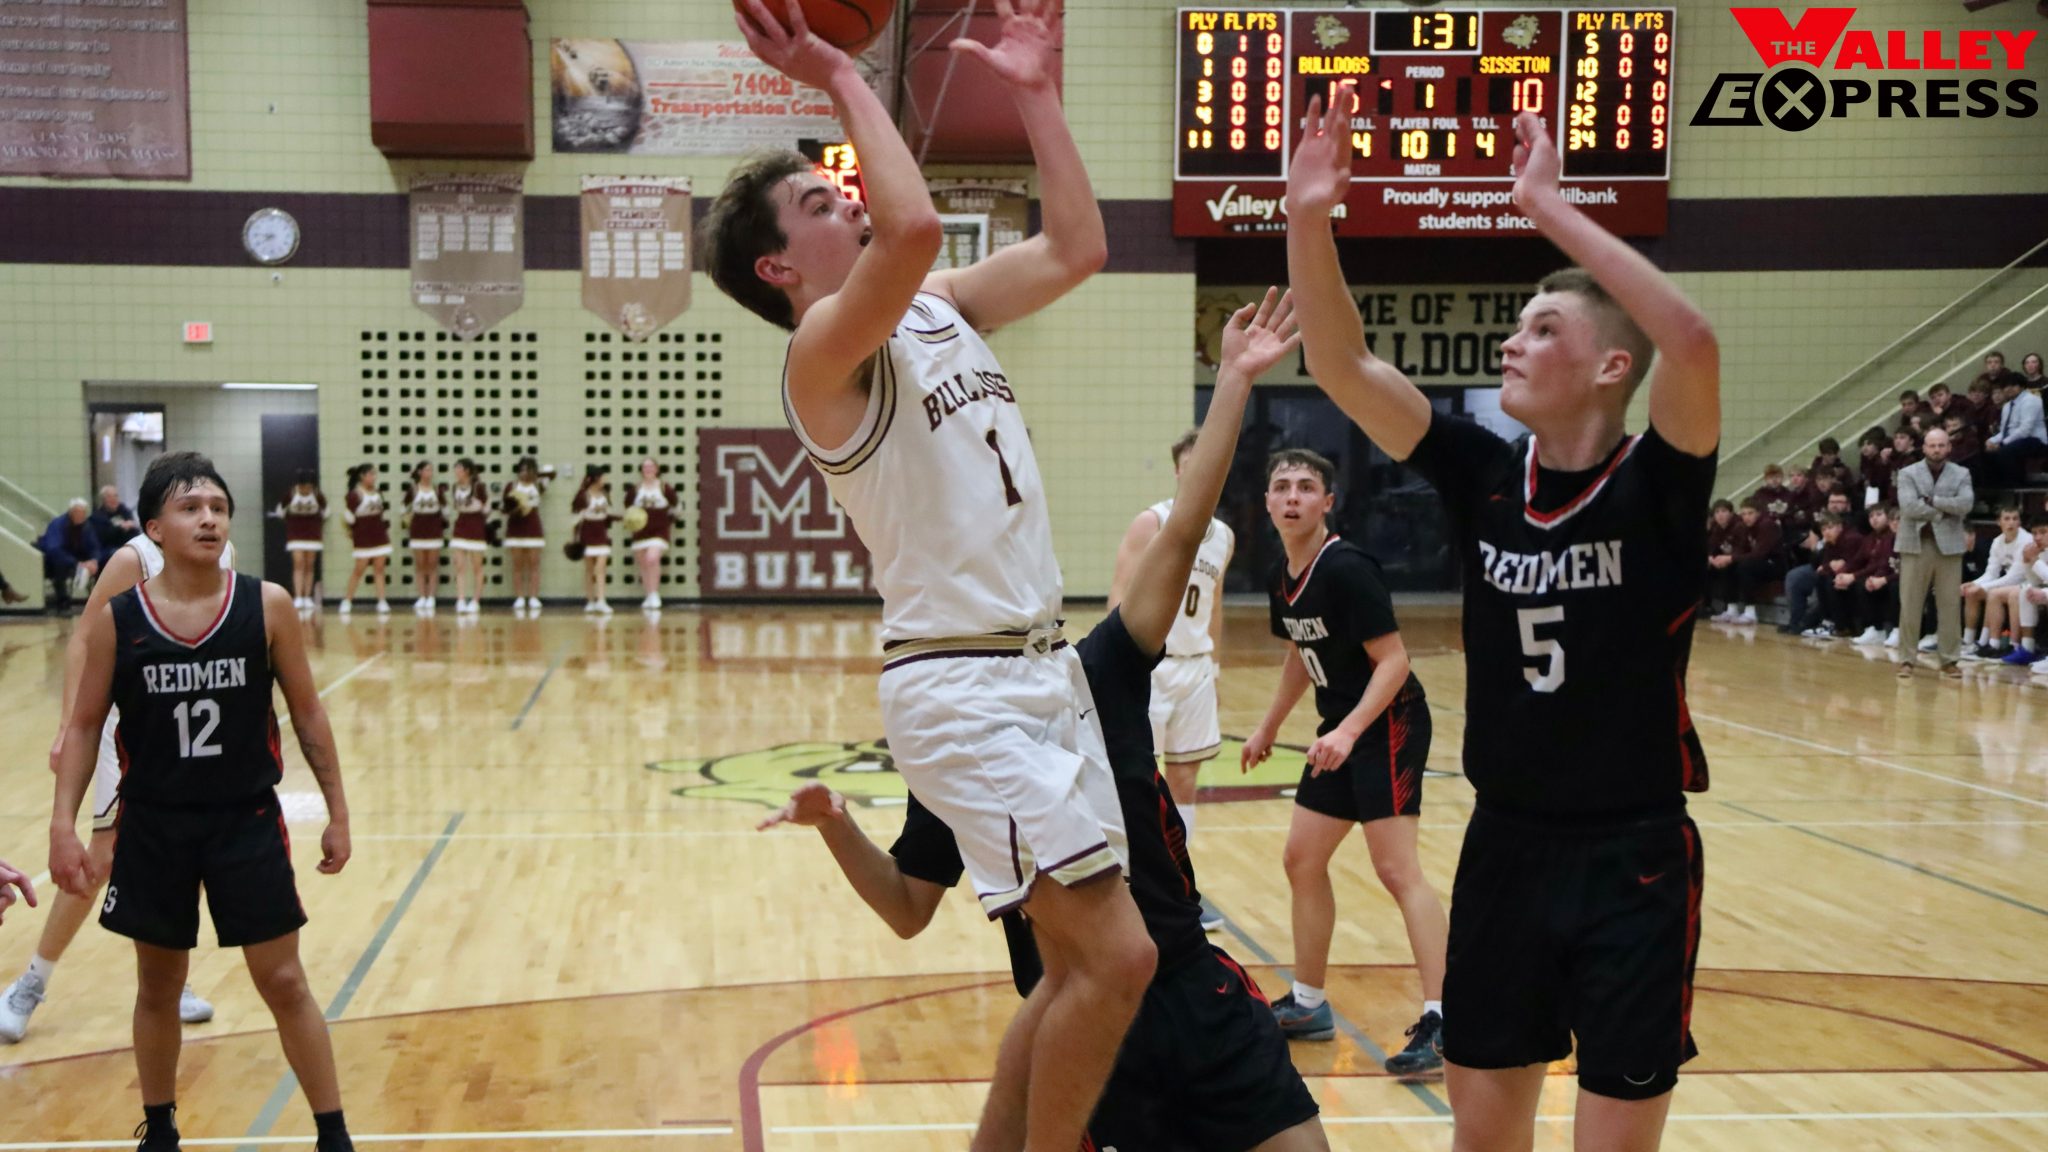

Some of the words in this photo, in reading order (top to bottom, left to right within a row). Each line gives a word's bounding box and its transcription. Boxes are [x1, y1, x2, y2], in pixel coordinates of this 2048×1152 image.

[1189, 13, 1217, 30] PLY
[1224, 13, 1243, 30] FL
[1246, 13, 1277, 30] PTS
[1413, 13, 1477, 49] 1:31
[1577, 13, 1604, 30] PLY
[1611, 13, 1629, 30] FL
[1634, 13, 1664, 30] PTS
[1197, 33, 1213, 54] 0
[1240, 35, 1247, 52] 1
[1267, 33, 1281, 54] 0
[1585, 33, 1599, 54] 5
[1619, 33, 1633, 53] 0
[1654, 33, 1668, 53] 0
[1204, 58, 1213, 77] 1
[1231, 57, 1247, 78] 0
[1266, 57, 1281, 78] 0
[1298, 56, 1370, 74] BULLDOGS
[1405, 66, 1444, 78] PERIOD
[1479, 56, 1550, 74] SISSETON
[1577, 57, 1599, 78] 10
[1619, 57, 1632, 78] 0
[1654, 58, 1667, 76] 4
[732, 72, 794, 96] 740th
[1198, 80, 1213, 103] 3
[1231, 81, 1246, 102] 0
[1266, 81, 1280, 102] 0
[1576, 81, 1598, 102] 12
[1625, 82, 1632, 100] 1
[1652, 81, 1666, 102] 0
[1425, 84, 1434, 109] 1
[1513, 78, 1543, 113] 10
[650, 97, 786, 118] Transportation
[790, 98, 841, 120] Comp
[1196, 105, 1212, 124] 4
[1231, 105, 1246, 126] 0
[1265, 105, 1280, 126] 0
[1570, 105, 1597, 126] 32
[1617, 105, 1631, 125] 0
[1651, 105, 1665, 125] 0
[1390, 117, 1430, 129] PLAYER
[1433, 117, 1460, 129] FOUL
[1472, 117, 1499, 129] T.O.L.
[1188, 129, 1212, 149] 11
[1230, 129, 1246, 150] 0
[1265, 129, 1280, 150] 0
[1352, 132, 1371, 157] 4
[1401, 130, 1429, 160] 10
[1476, 132, 1495, 157] 4
[1569, 128, 1596, 150] 34
[1616, 128, 1629, 150] 0
[1652, 128, 1664, 150] 3
[1404, 164, 1441, 176] MATCH
[1206, 184, 1277, 221] Valley
[1383, 187, 1449, 208] Proudly
[1452, 191, 1514, 208] suppor
[1419, 212, 1492, 230] students
[1411, 293, 1455, 325] OF
[985, 428, 1023, 507] 1
[1478, 539, 1622, 594] REDMEN
[1516, 605, 1565, 693] 5
[143, 657, 246, 693] REDMEN
[172, 698, 223, 758] 12
[103, 885, 118, 913] S
